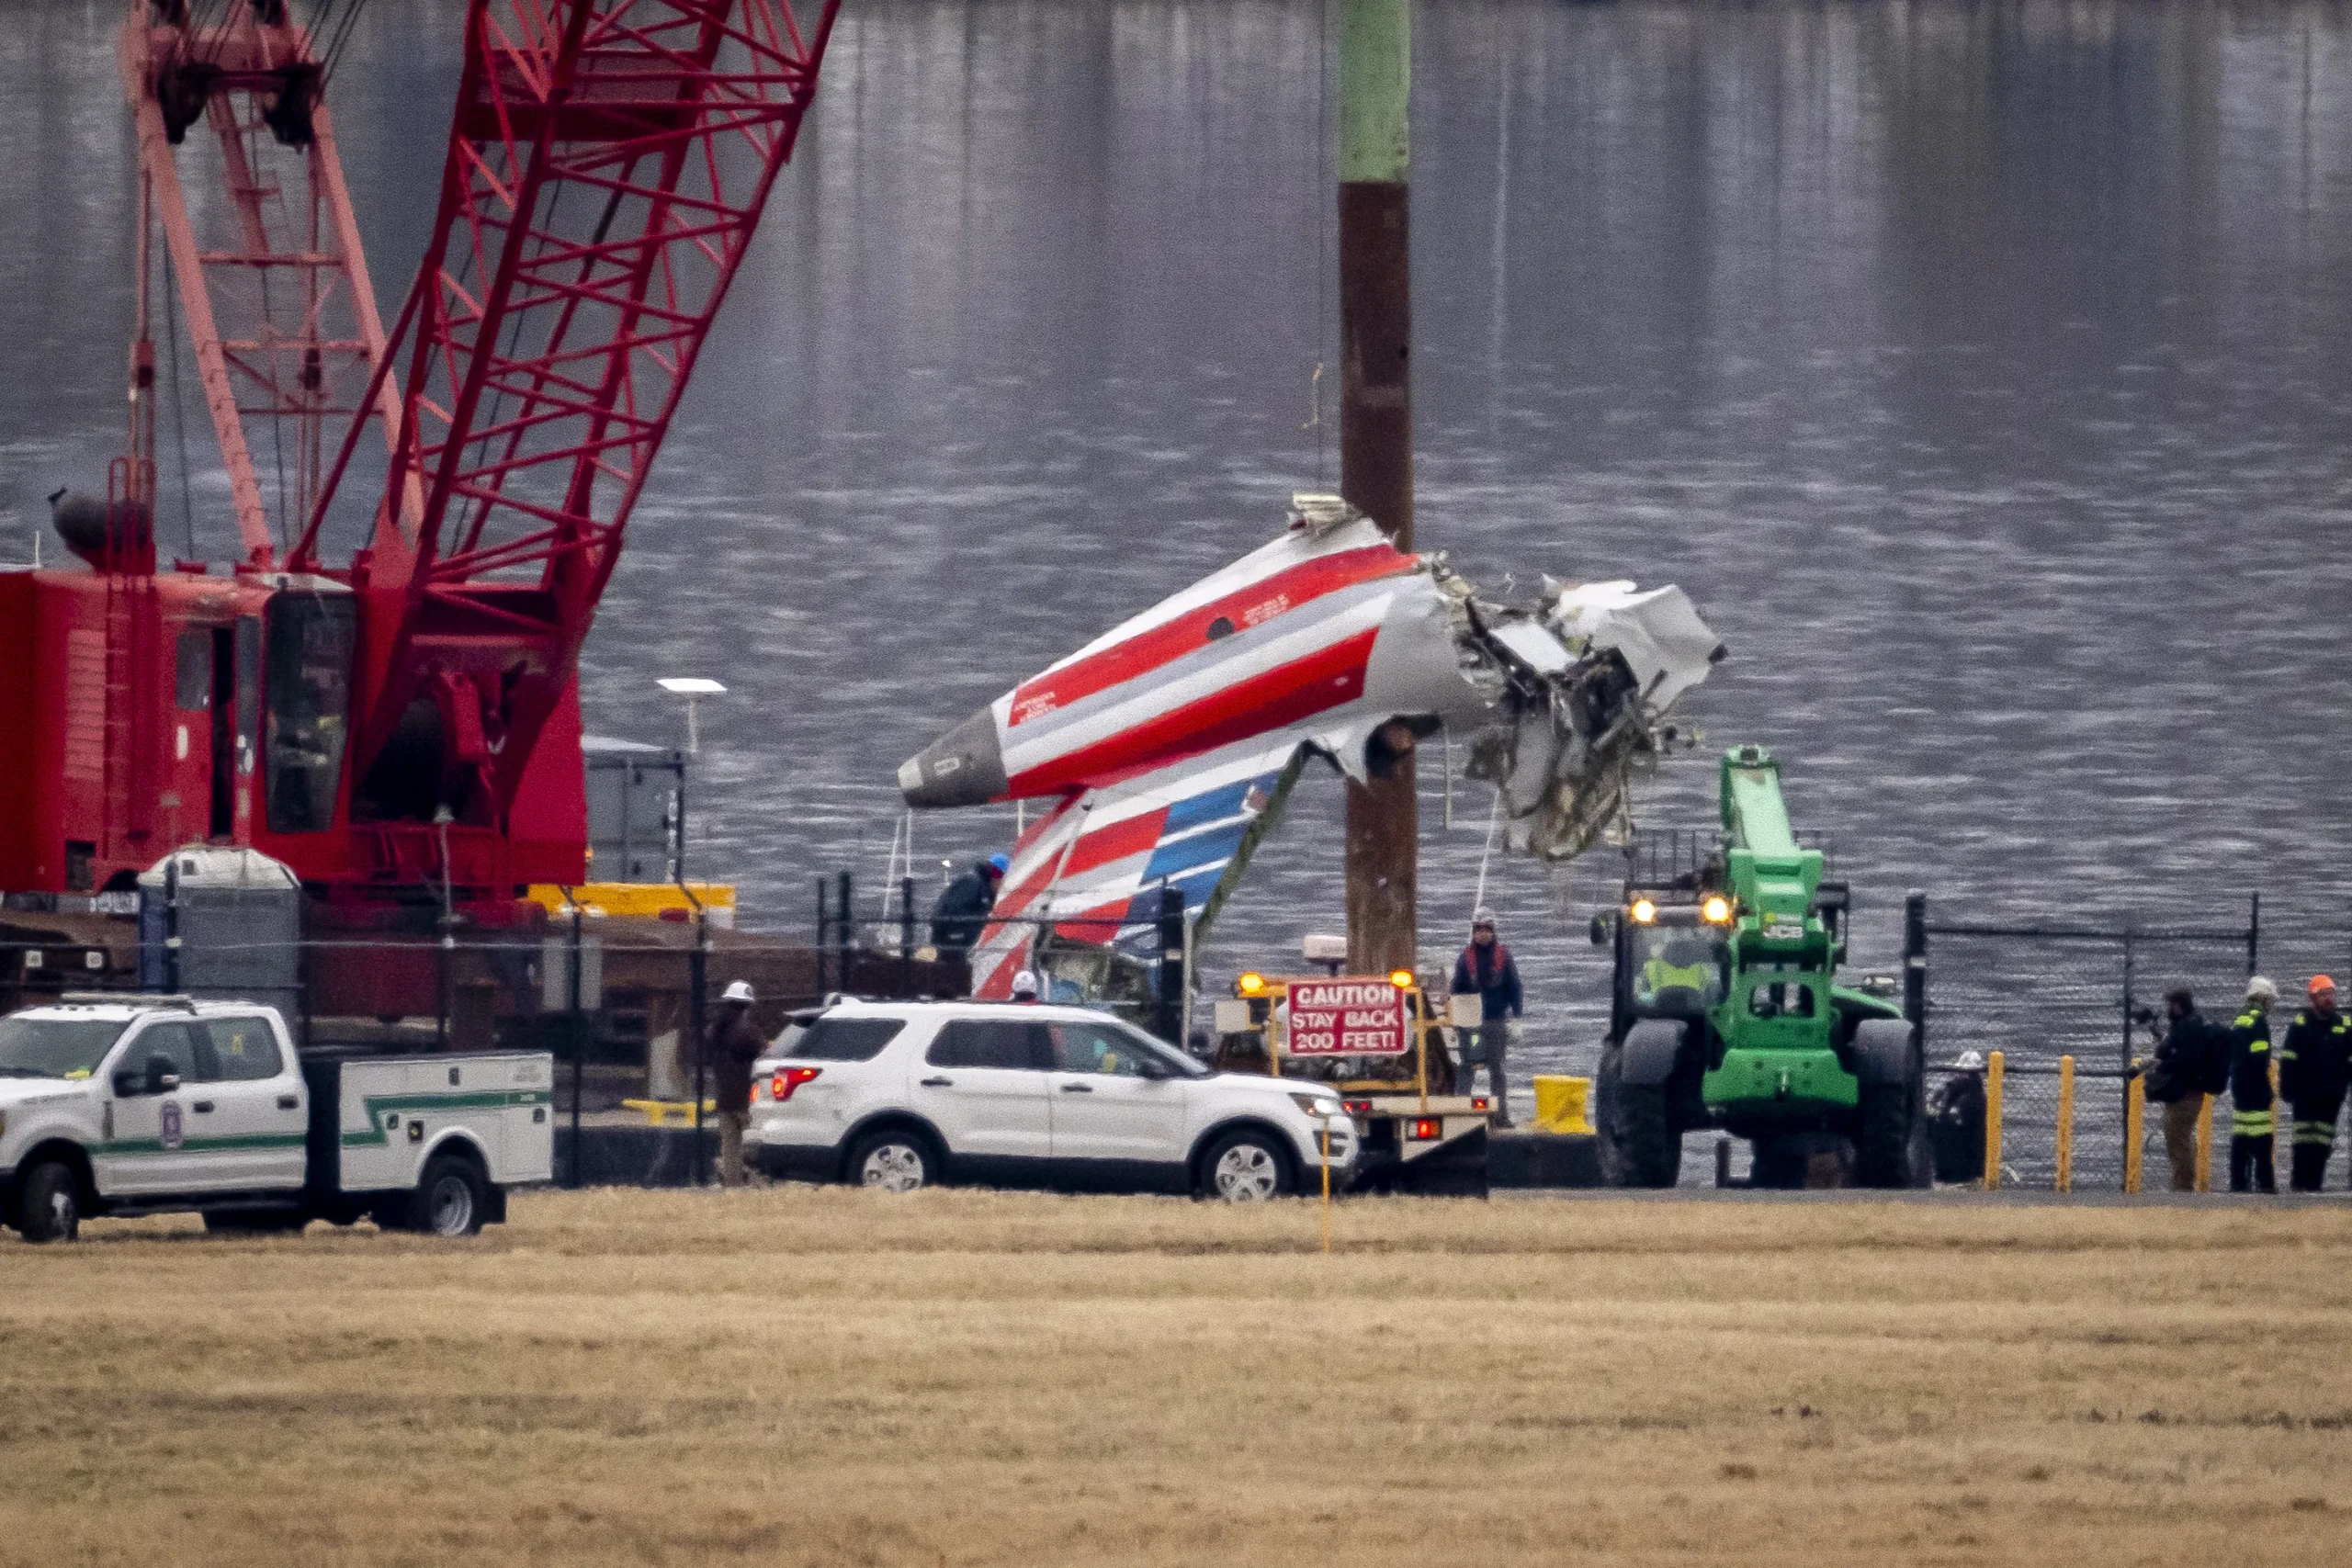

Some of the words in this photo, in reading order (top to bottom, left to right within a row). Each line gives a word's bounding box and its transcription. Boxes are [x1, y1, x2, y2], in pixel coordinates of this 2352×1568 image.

[1763, 925, 1804, 938] JCB
[1296, 987, 1396, 1005] CAUTION
[1292, 1012, 1337, 1028] STAY
[1345, 1010, 1398, 1027] BACK
[1296, 1032, 1335, 1049] 200
[1342, 1031, 1396, 1048] FEET!
